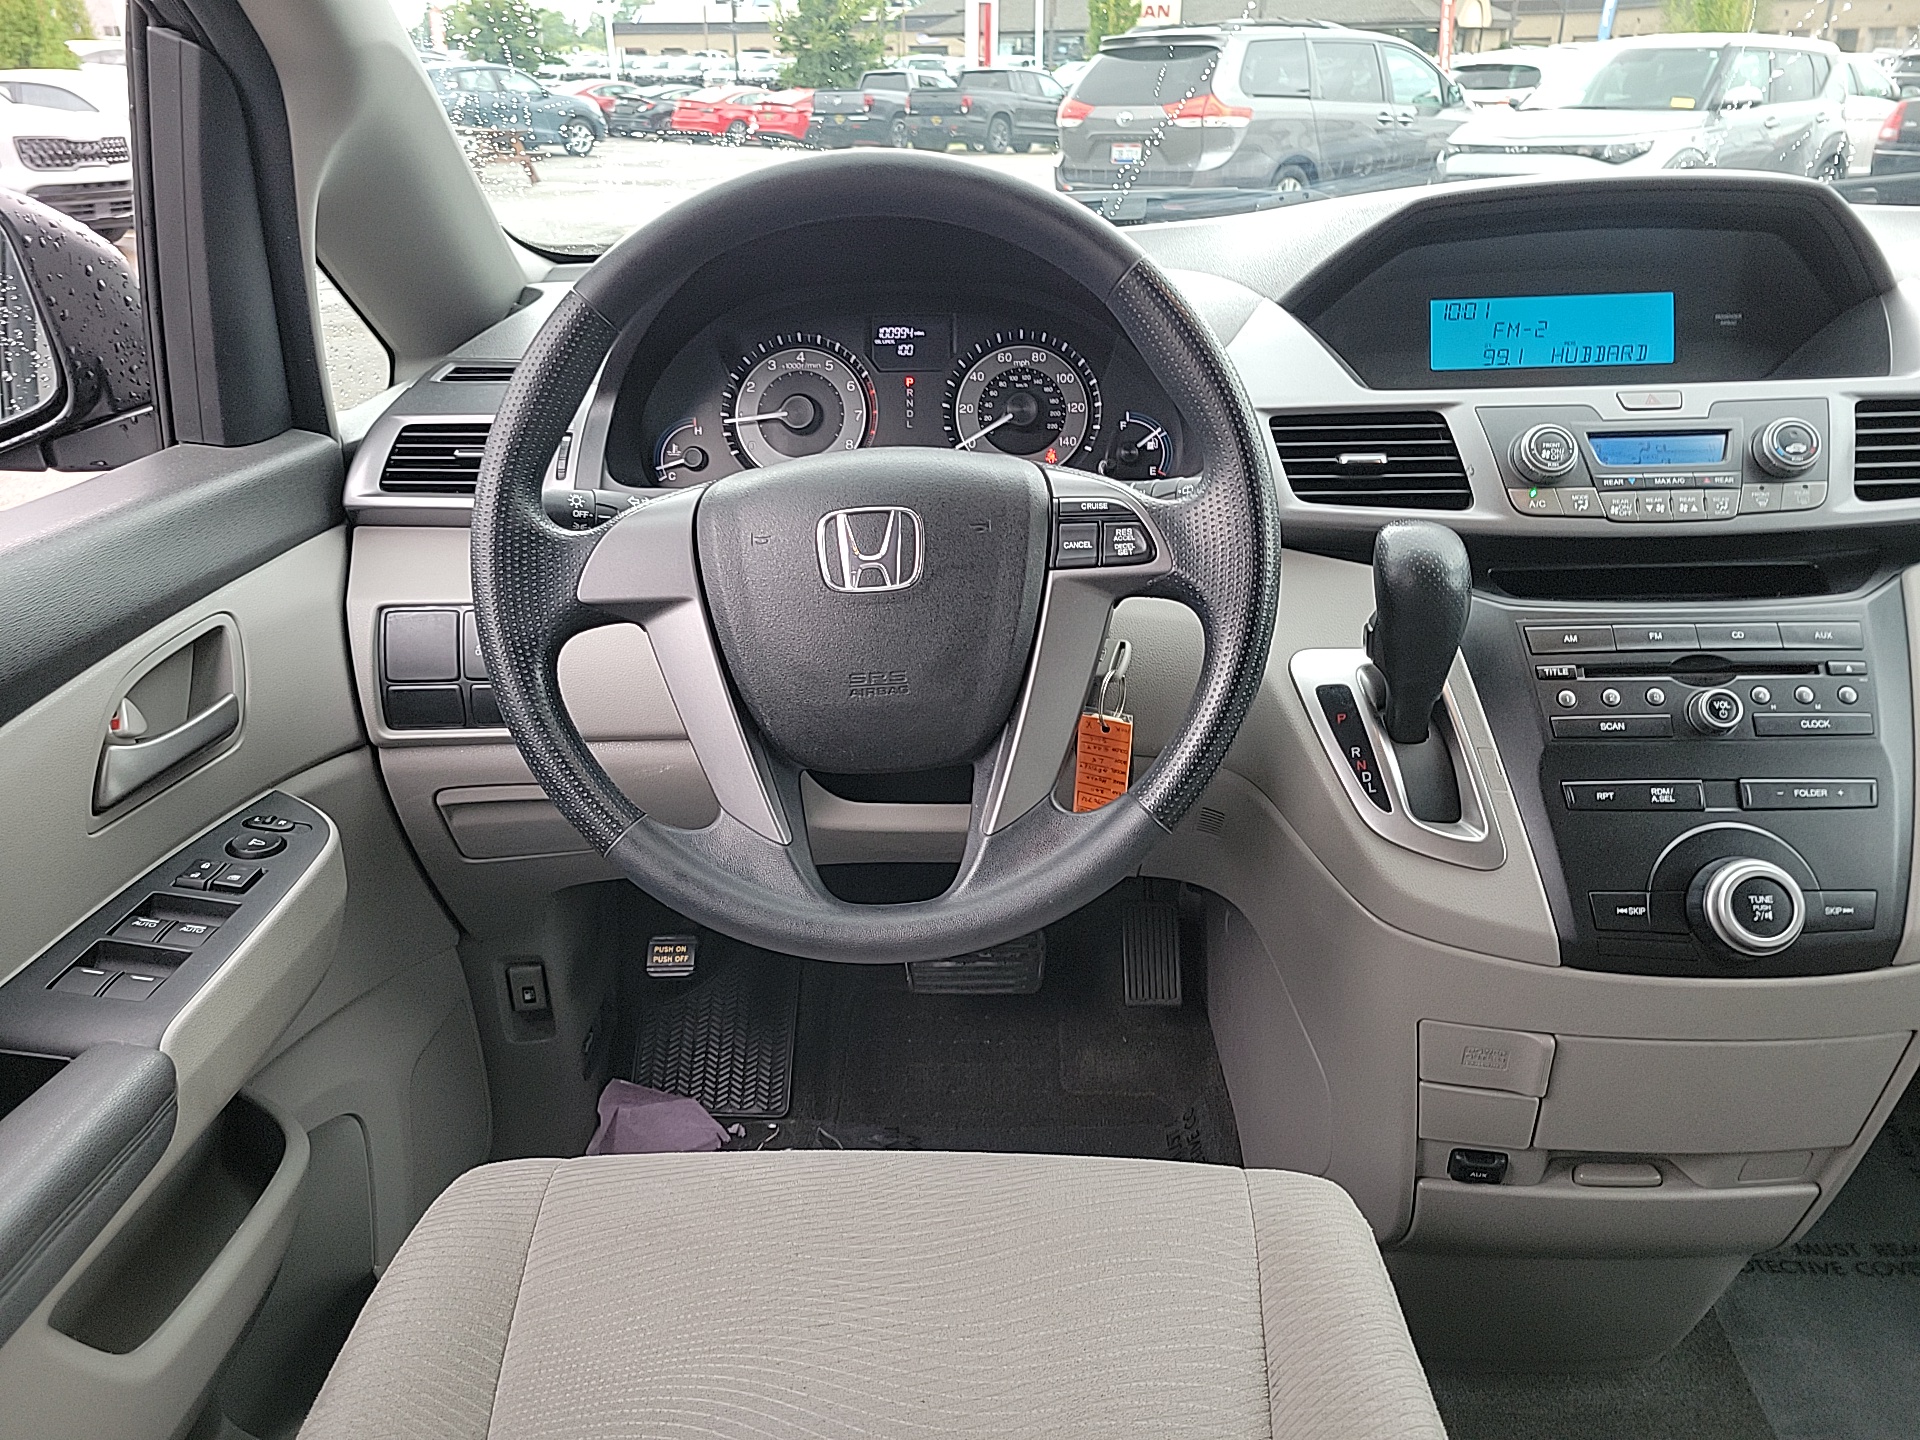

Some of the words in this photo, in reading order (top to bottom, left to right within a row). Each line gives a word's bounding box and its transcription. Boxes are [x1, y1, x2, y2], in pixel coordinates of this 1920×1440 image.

[879, 327, 914, 339] 100994
[1493, 321, 1548, 339] FM-2
[796, 352, 806, 362] 4
[997, 352, 1012, 362] 60
[1031, 352, 1047, 362] 80
[1484, 348, 1524, 366] 99.1
[767, 360, 777, 371] 3
[825, 360, 834, 371] 5
[969, 371, 985, 382] 40
[1056, 373, 1074, 383] 100
[746, 381, 756, 393] 2
[846, 380, 855, 391] 6
[905, 377, 914, 388] P
[906, 389, 914, 397] R
[906, 399, 914, 408] N
[1067, 403, 1085, 413] 120
[906, 410, 914, 418] D
[959, 404, 974, 414] 20
[854, 410, 863, 421] 7
[906, 420, 913, 429] L
[1120, 420, 1127, 430] F
[694, 426, 703, 436] H
[845, 439, 854, 450] 8
[1059, 436, 1077, 447] 140
[1149, 466, 1157, 476] E
[668, 472, 677, 481] C
[572, 510, 590, 518] OFF
[1063, 541, 1092, 550] CANCEL
[1563, 634, 1578, 643] AM
[1648, 632, 1663, 640] FM
[1730, 631, 1745, 640] CD
[1814, 631, 1834, 640] AUX
[1544, 668, 1569, 676] TITLE
[1714, 701, 1732, 709] VOL
[1337, 714, 1347, 725] P
[1800, 720, 1831, 728] CLOCK
[1600, 722, 1626, 730] SCAN
[1351, 747, 1361, 759] R
[1356, 760, 1367, 770] N
[1362, 771, 1372, 782] D
[1368, 783, 1376, 793] L
[1794, 788, 1828, 798] FOLDER
[1596, 792, 1614, 800] RPT
[1748, 895, 1774, 904] TUNE
[1628, 906, 1646, 916] SKIP
[1824, 906, 1842, 916] SKIP
